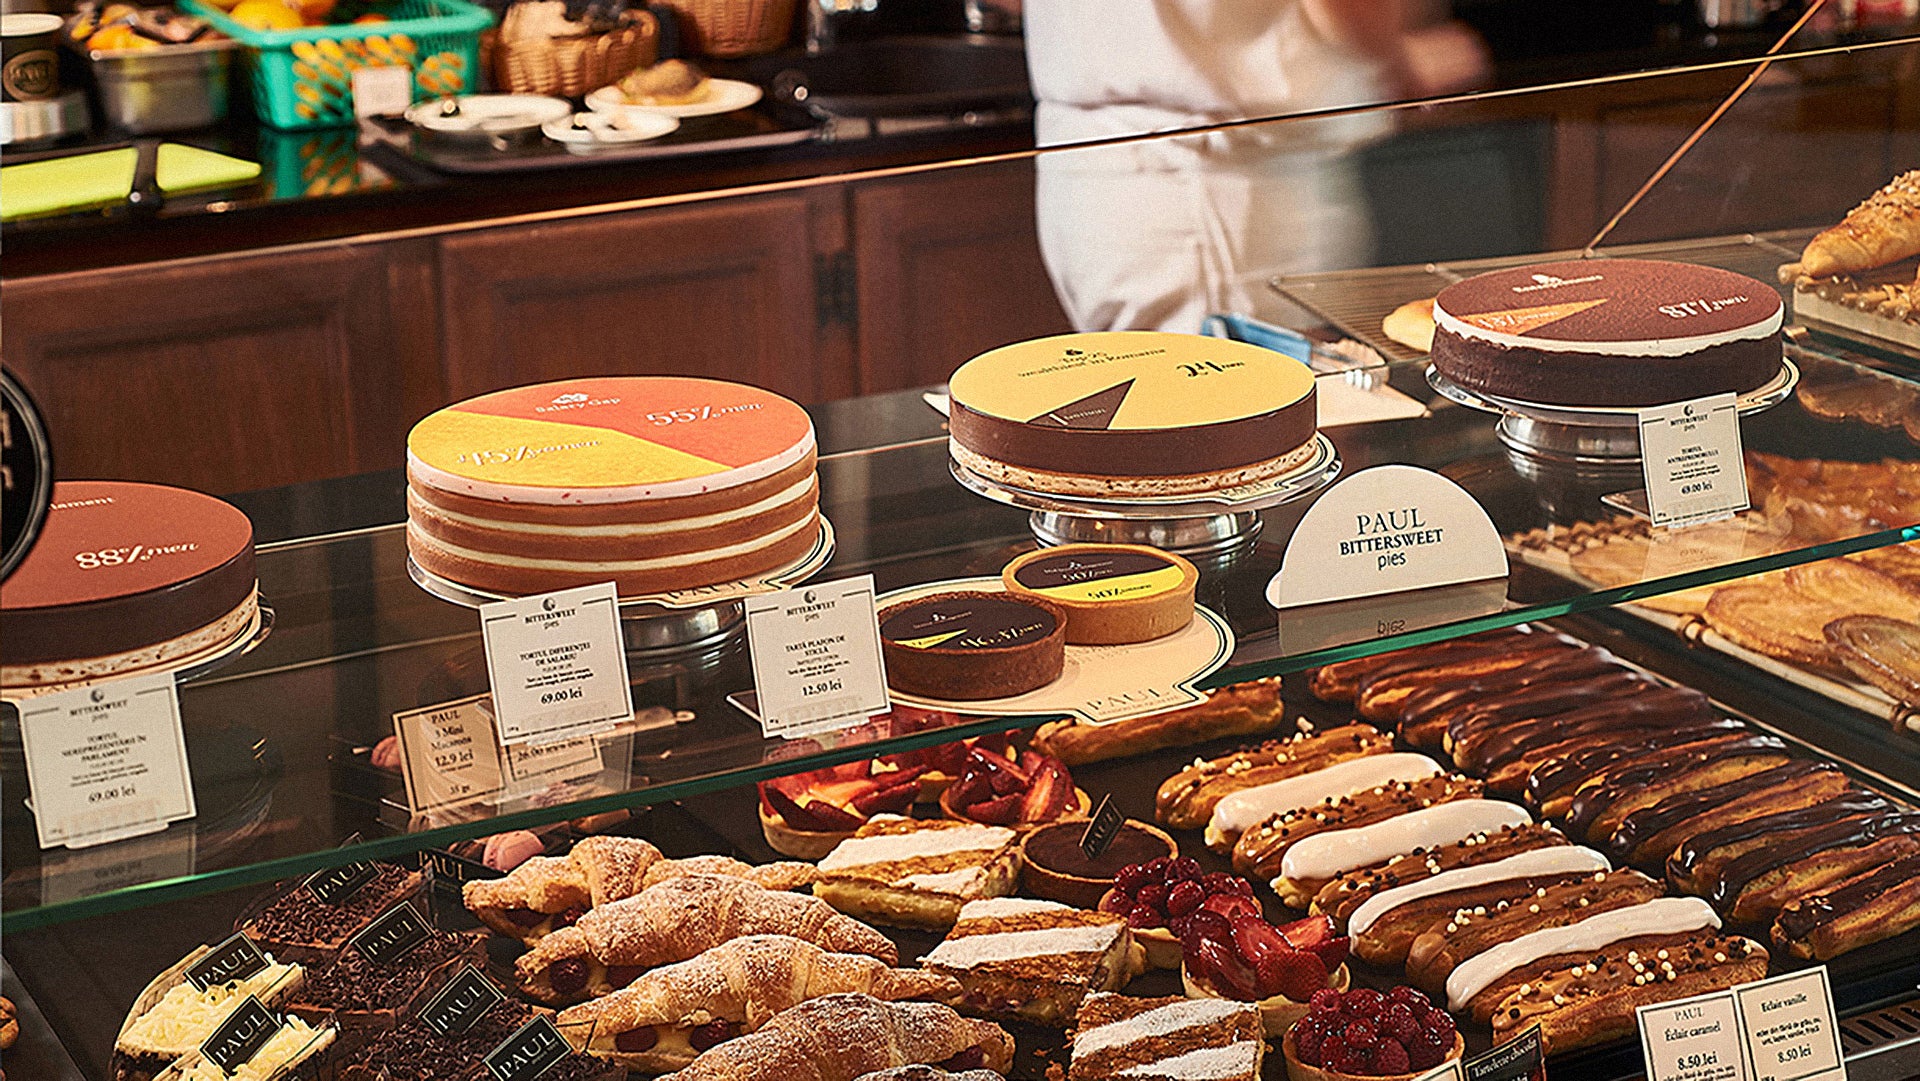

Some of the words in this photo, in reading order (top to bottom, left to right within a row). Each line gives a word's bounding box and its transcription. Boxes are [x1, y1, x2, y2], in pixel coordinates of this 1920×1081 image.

[1357, 508, 1426, 536] PAUL
[1340, 529, 1443, 556] BITTERSWEET
[1377, 551, 1406, 571] pies
[525, 608, 576, 624] BITTERSWEET
[787, 601, 836, 616] BITTERSWEET
[541, 690, 568, 704] 69.00
[569, 687, 583, 700] lei
[803, 682, 829, 696] 12.50
[829, 679, 843, 692] lei
[431, 710, 461, 724] PAUL
[435, 752, 457, 767] 12.9
[458, 748, 474, 763] lei
[121, 784, 136, 797] lei
[368, 920, 417, 955] PAUL
[199, 948, 255, 987] PAUL
[437, 986, 486, 1030] PAUL
[1674, 1006, 1704, 1022] PAUL
[216, 1014, 267, 1063] PAUL
[1664, 1027, 1688, 1042] Éclair
[1690, 1020, 1720, 1038] caramel
[499, 1033, 556, 1078] PAUL
[1678, 1053, 1701, 1071] 8.50
[1702, 1050, 1718, 1067] lei
[1777, 1047, 1799, 1064] 8.50
[1799, 1043, 1812, 1058] lei
